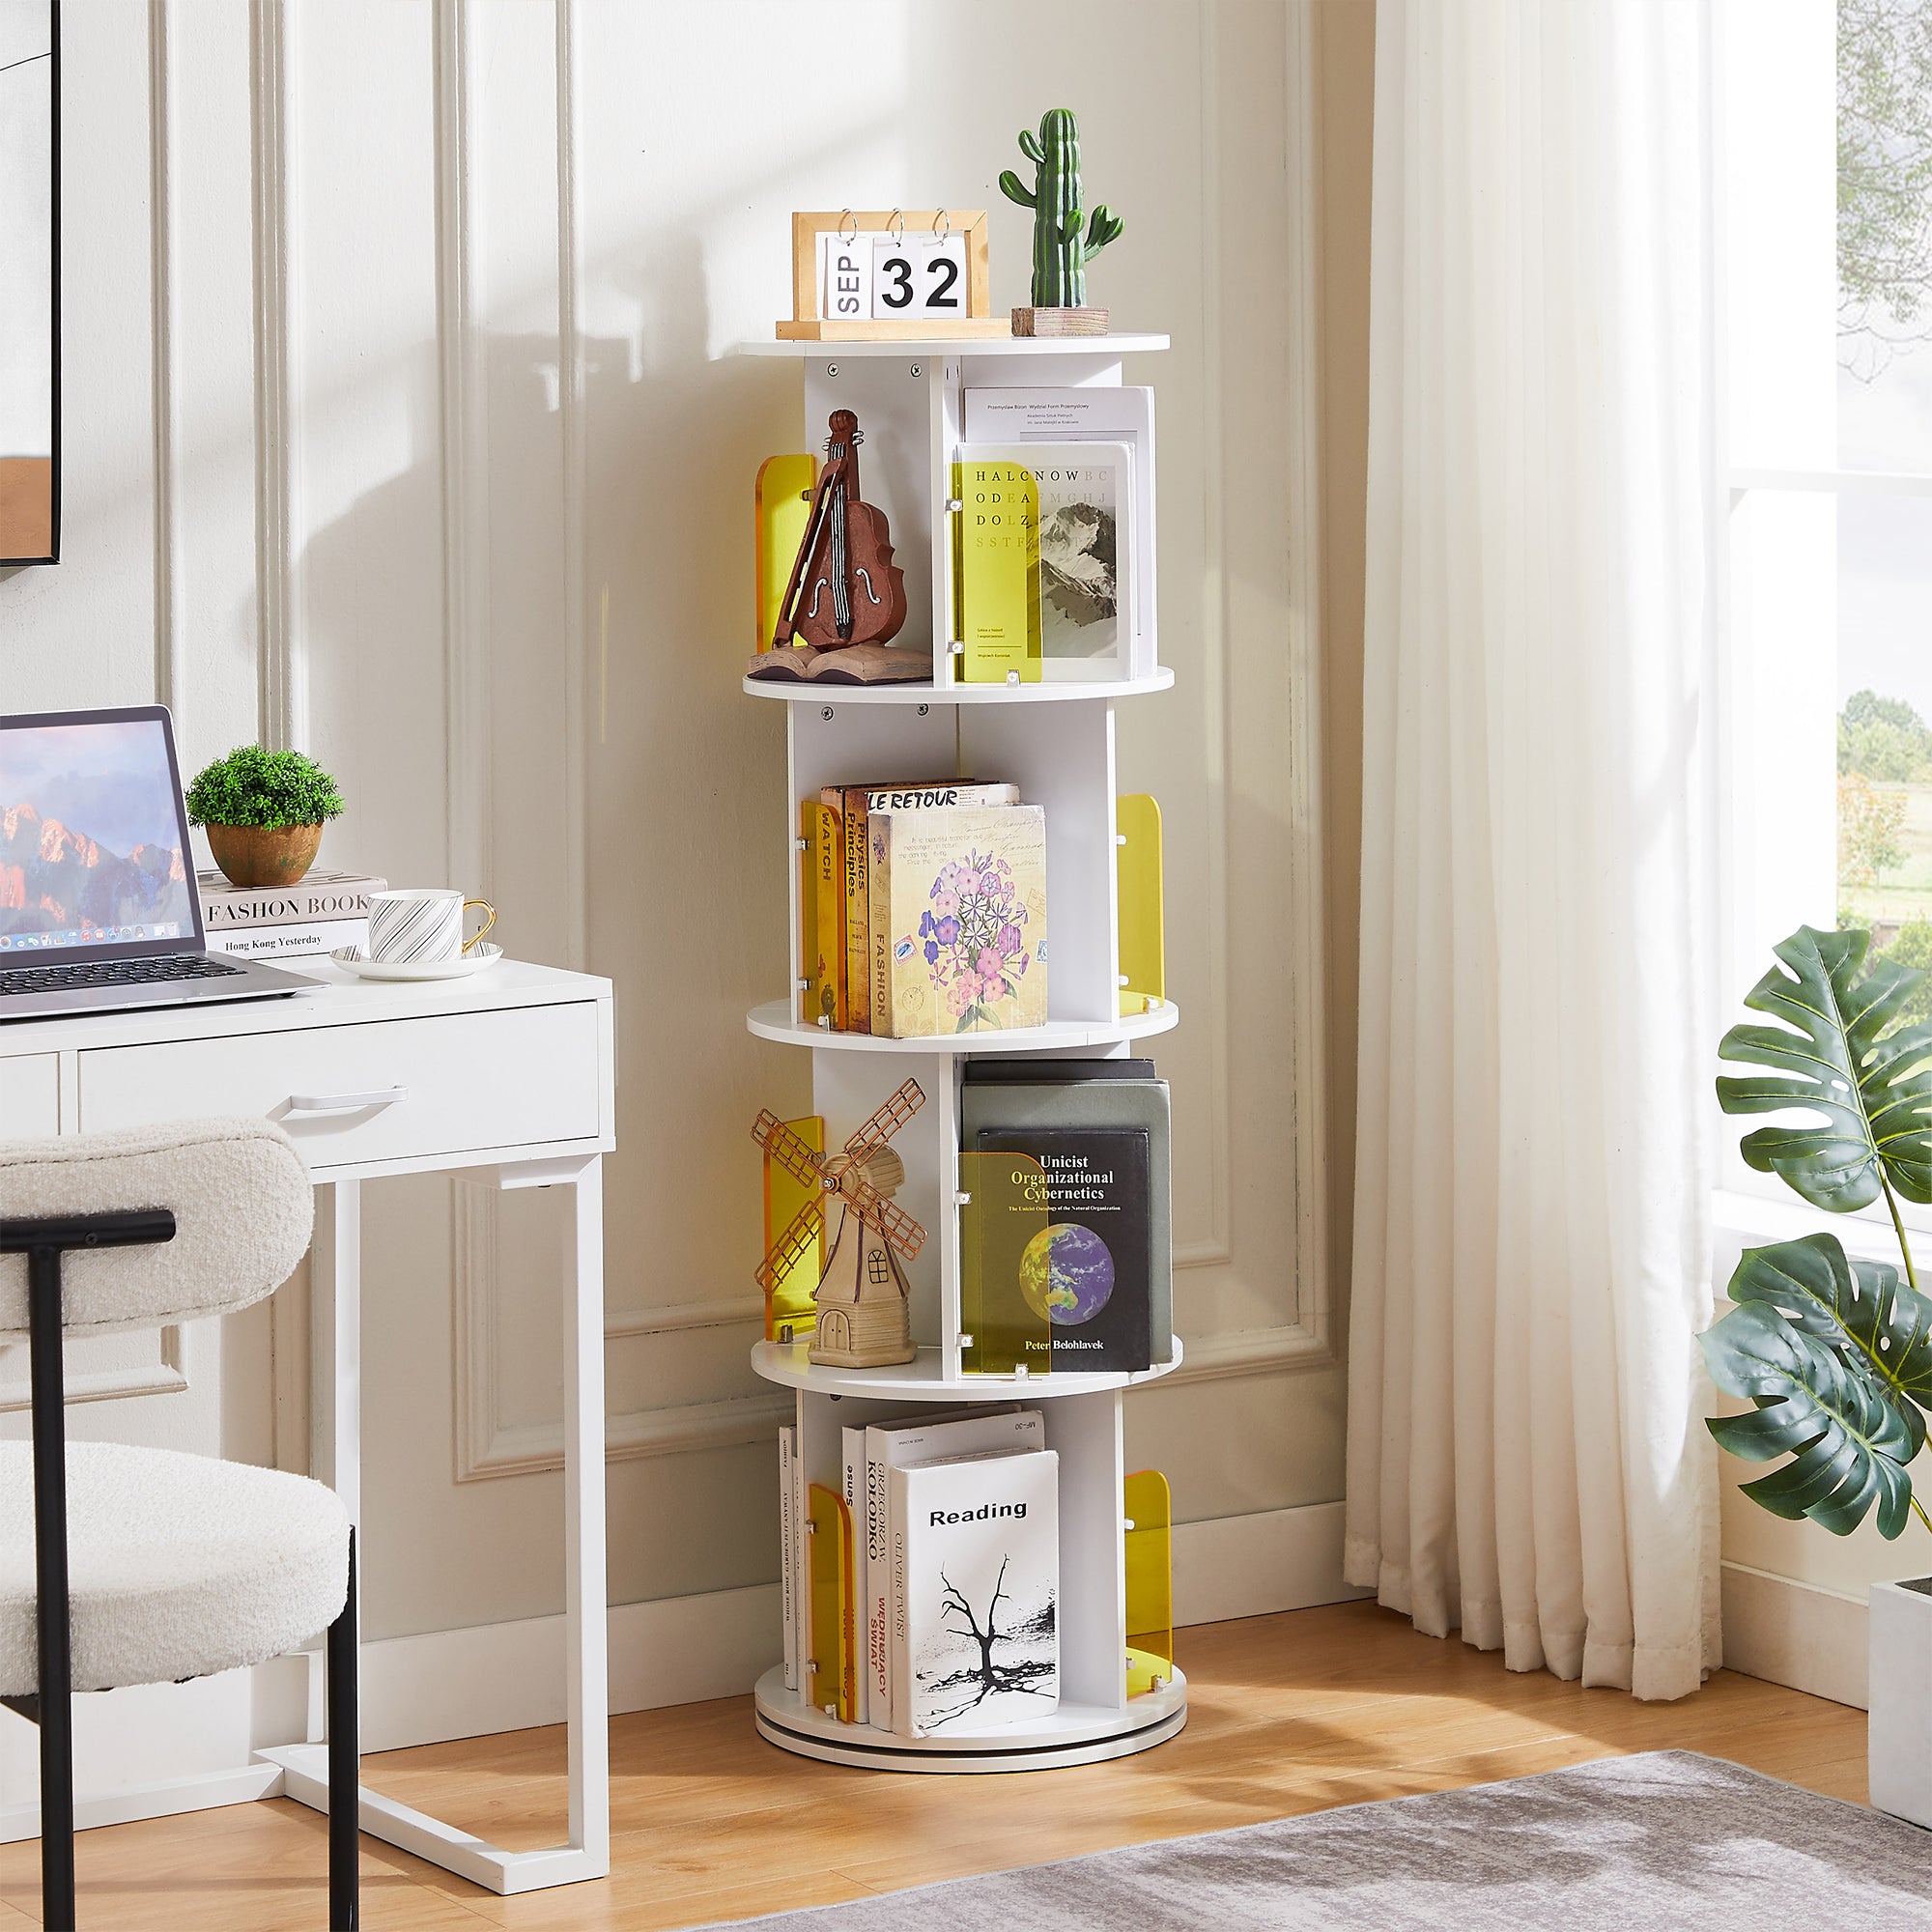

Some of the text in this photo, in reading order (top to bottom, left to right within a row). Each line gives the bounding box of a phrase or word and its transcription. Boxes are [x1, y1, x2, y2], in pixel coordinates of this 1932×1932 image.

[838, 255, 860, 314] SEP
[867, 792, 888, 810] LE
[890, 788, 958, 810] RETOUR
[820, 811, 832, 881] WATCH
[846, 811, 857, 897] Principles
[856, 821, 867, 891] Physics
[208, 898, 301, 923] FASHON
[225, 935, 323, 952] Hong Kong Yesterday
[875, 933, 887, 1018] FASHION
[1039, 1153, 1089, 1168] Unicist
[1010, 1169, 1115, 1186] Organizational
[1024, 1186, 1105, 1202] Cybernetics
[1025, 1339, 1104, 1351] Peter Belohlavek
[845, 1464, 854, 1507] Sense
[929, 1499, 1029, 1528] Reading
[894, 1532, 905, 1642] OLIVER TWIST
